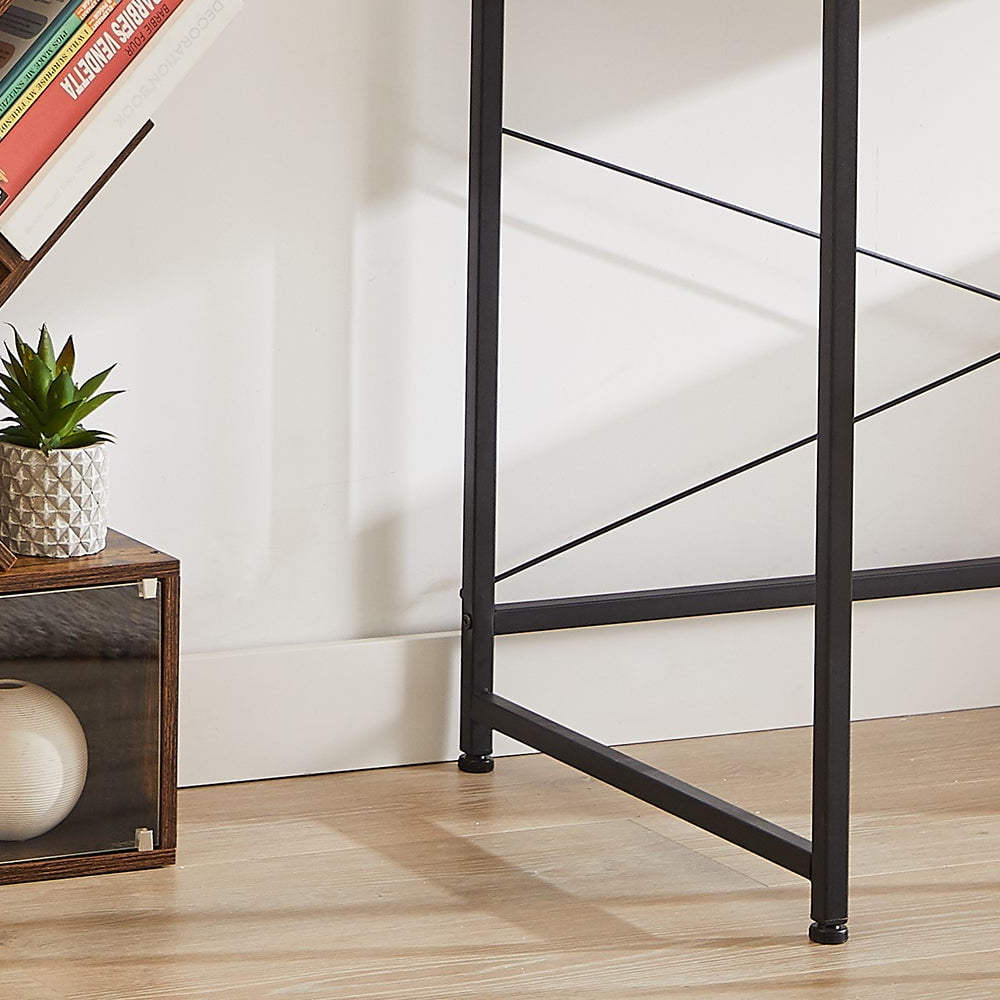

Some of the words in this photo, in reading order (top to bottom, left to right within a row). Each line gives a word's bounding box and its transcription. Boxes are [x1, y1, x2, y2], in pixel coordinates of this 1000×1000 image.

[142, 2, 170, 35] BARBIE
[50, 28, 68, 49] PIGS
[65, 33, 84, 54] WILL
[123, 30, 147, 58] FOUR
[33, 46, 54, 69] MAKE
[58, 29, 121, 102] VENDETTA
[23, 67, 36, 81] ME
[34, 52, 68, 90] SURPRISE
[23, 89, 37, 103] MY
[111, 84, 152, 130] BOOK
